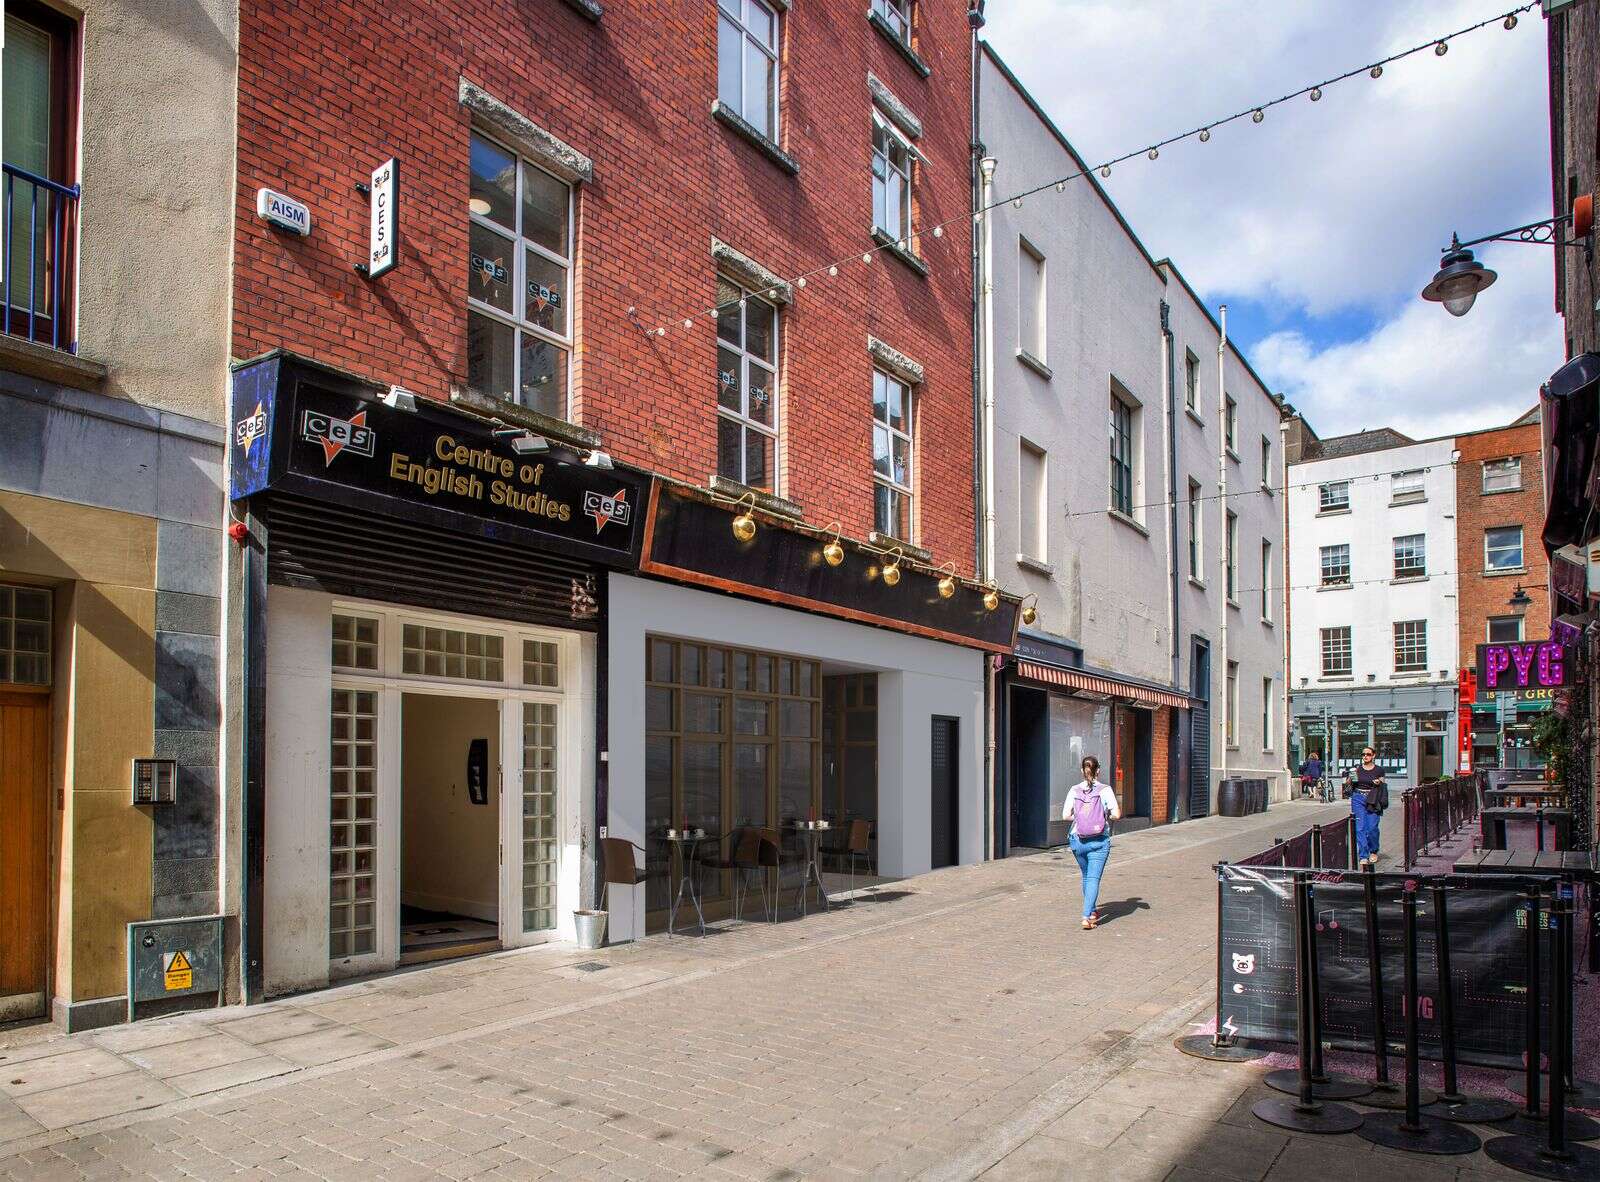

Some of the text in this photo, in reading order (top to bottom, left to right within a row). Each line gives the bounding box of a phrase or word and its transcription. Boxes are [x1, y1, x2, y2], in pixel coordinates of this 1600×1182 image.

[272, 200, 304, 224] AISM
[436, 435, 544, 486] Centre of
[389, 452, 571, 522] English Studies
[1486, 643, 1564, 688] PYG
